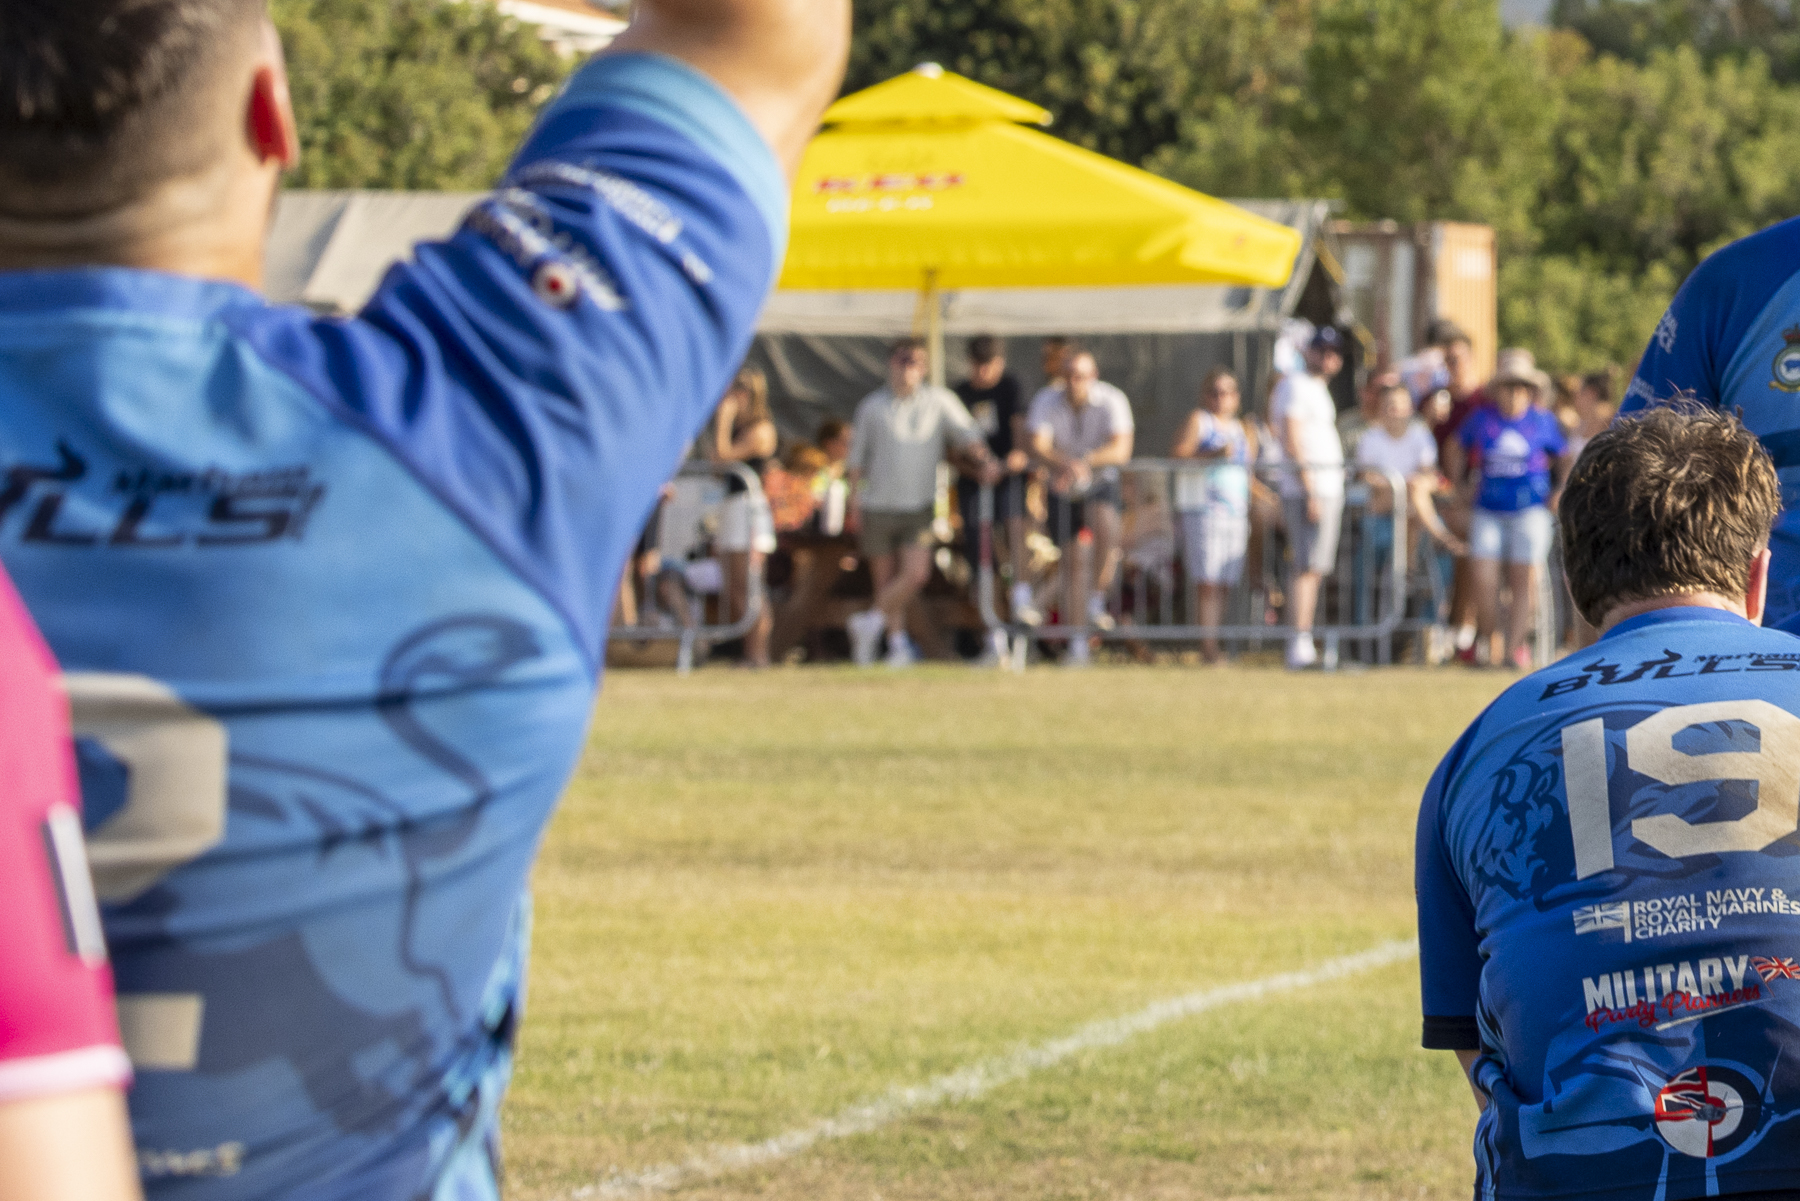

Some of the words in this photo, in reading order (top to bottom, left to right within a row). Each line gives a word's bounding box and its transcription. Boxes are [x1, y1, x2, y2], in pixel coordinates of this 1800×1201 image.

[1634, 894, 1701, 914] ROYAL
[1706, 887, 1765, 905] NAVY
[1770, 887, 1787, 901] &
[1635, 907, 1701, 928] ROYAL
[1635, 916, 1722, 940] CHARITY
[1582, 954, 1749, 1014] MILITARY
[1585, 1000, 1659, 1034] Party
[1661, 984, 1761, 1017] Planners
